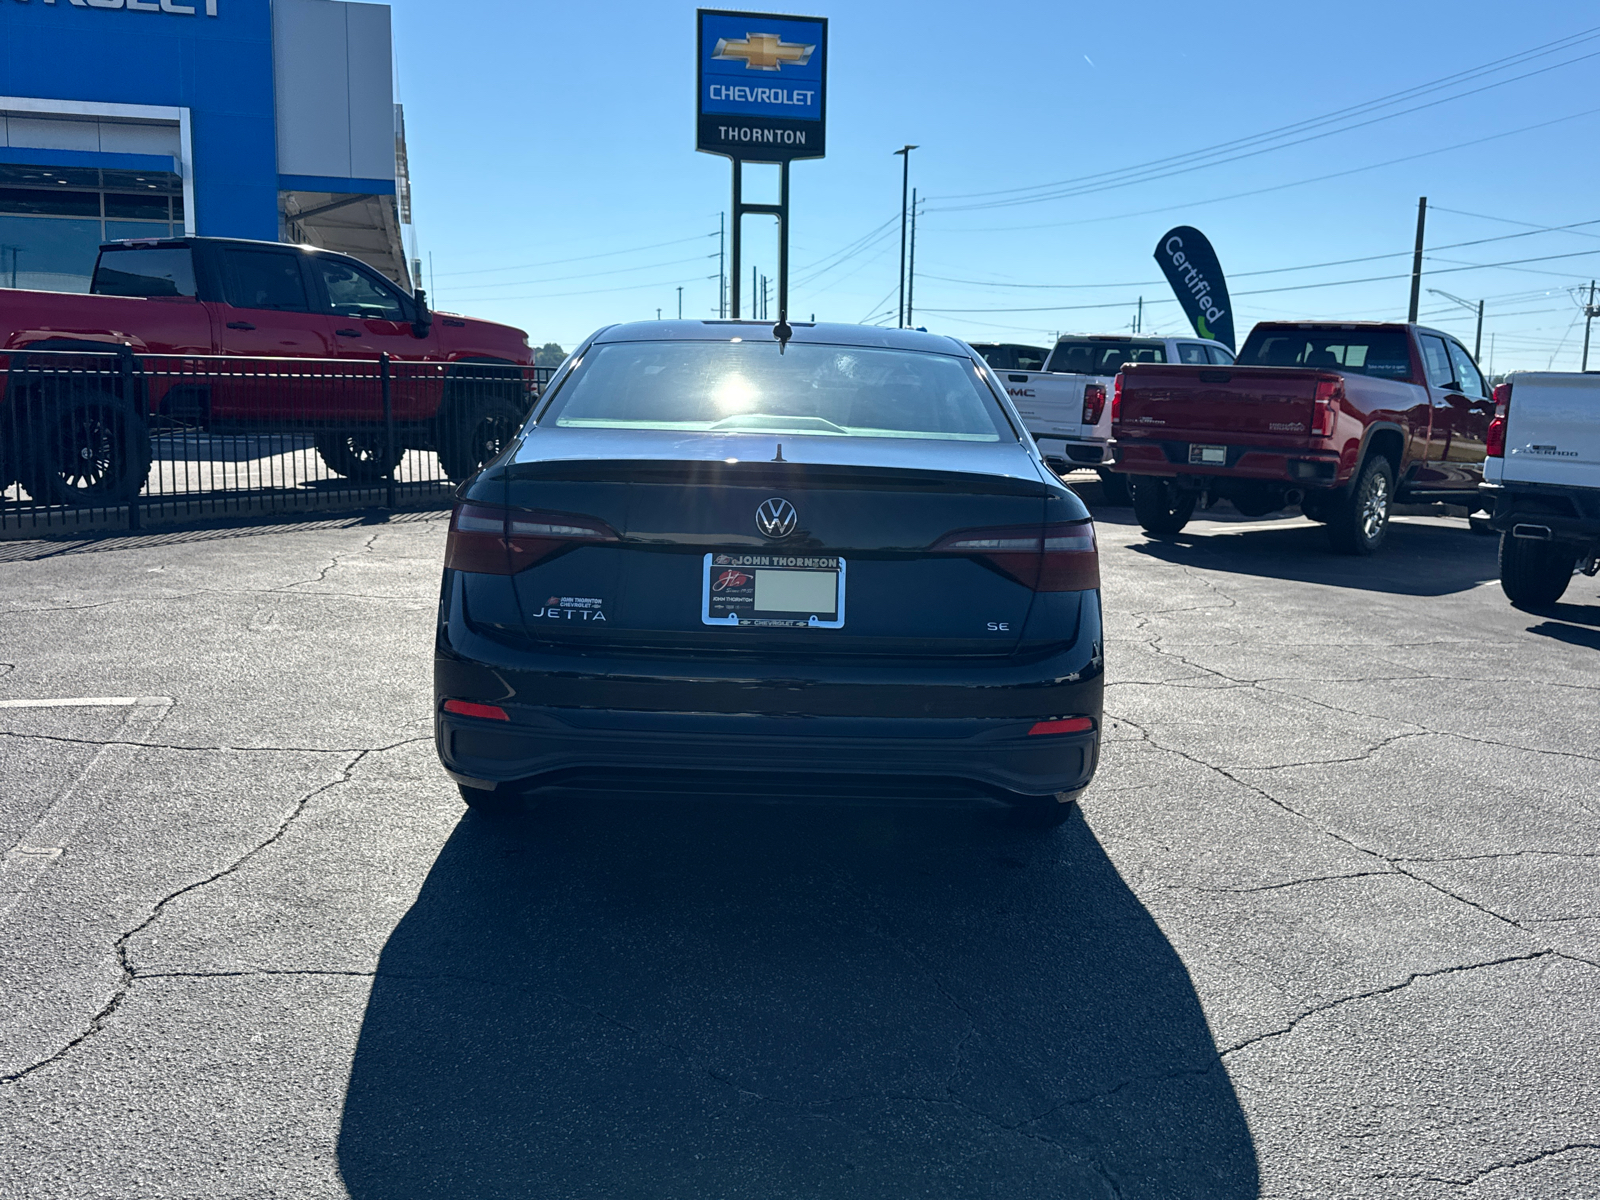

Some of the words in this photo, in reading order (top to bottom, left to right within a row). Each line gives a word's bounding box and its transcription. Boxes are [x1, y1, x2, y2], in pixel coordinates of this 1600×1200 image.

[710, 85, 815, 105] CHEVROLET
[719, 126, 806, 144] THORNTON
[1166, 236, 1225, 324] Certified
[737, 556, 770, 566] JOHN
[773, 557, 837, 567] THORNTON
[533, 607, 606, 621] JETTA
[987, 622, 1009, 631] SE
